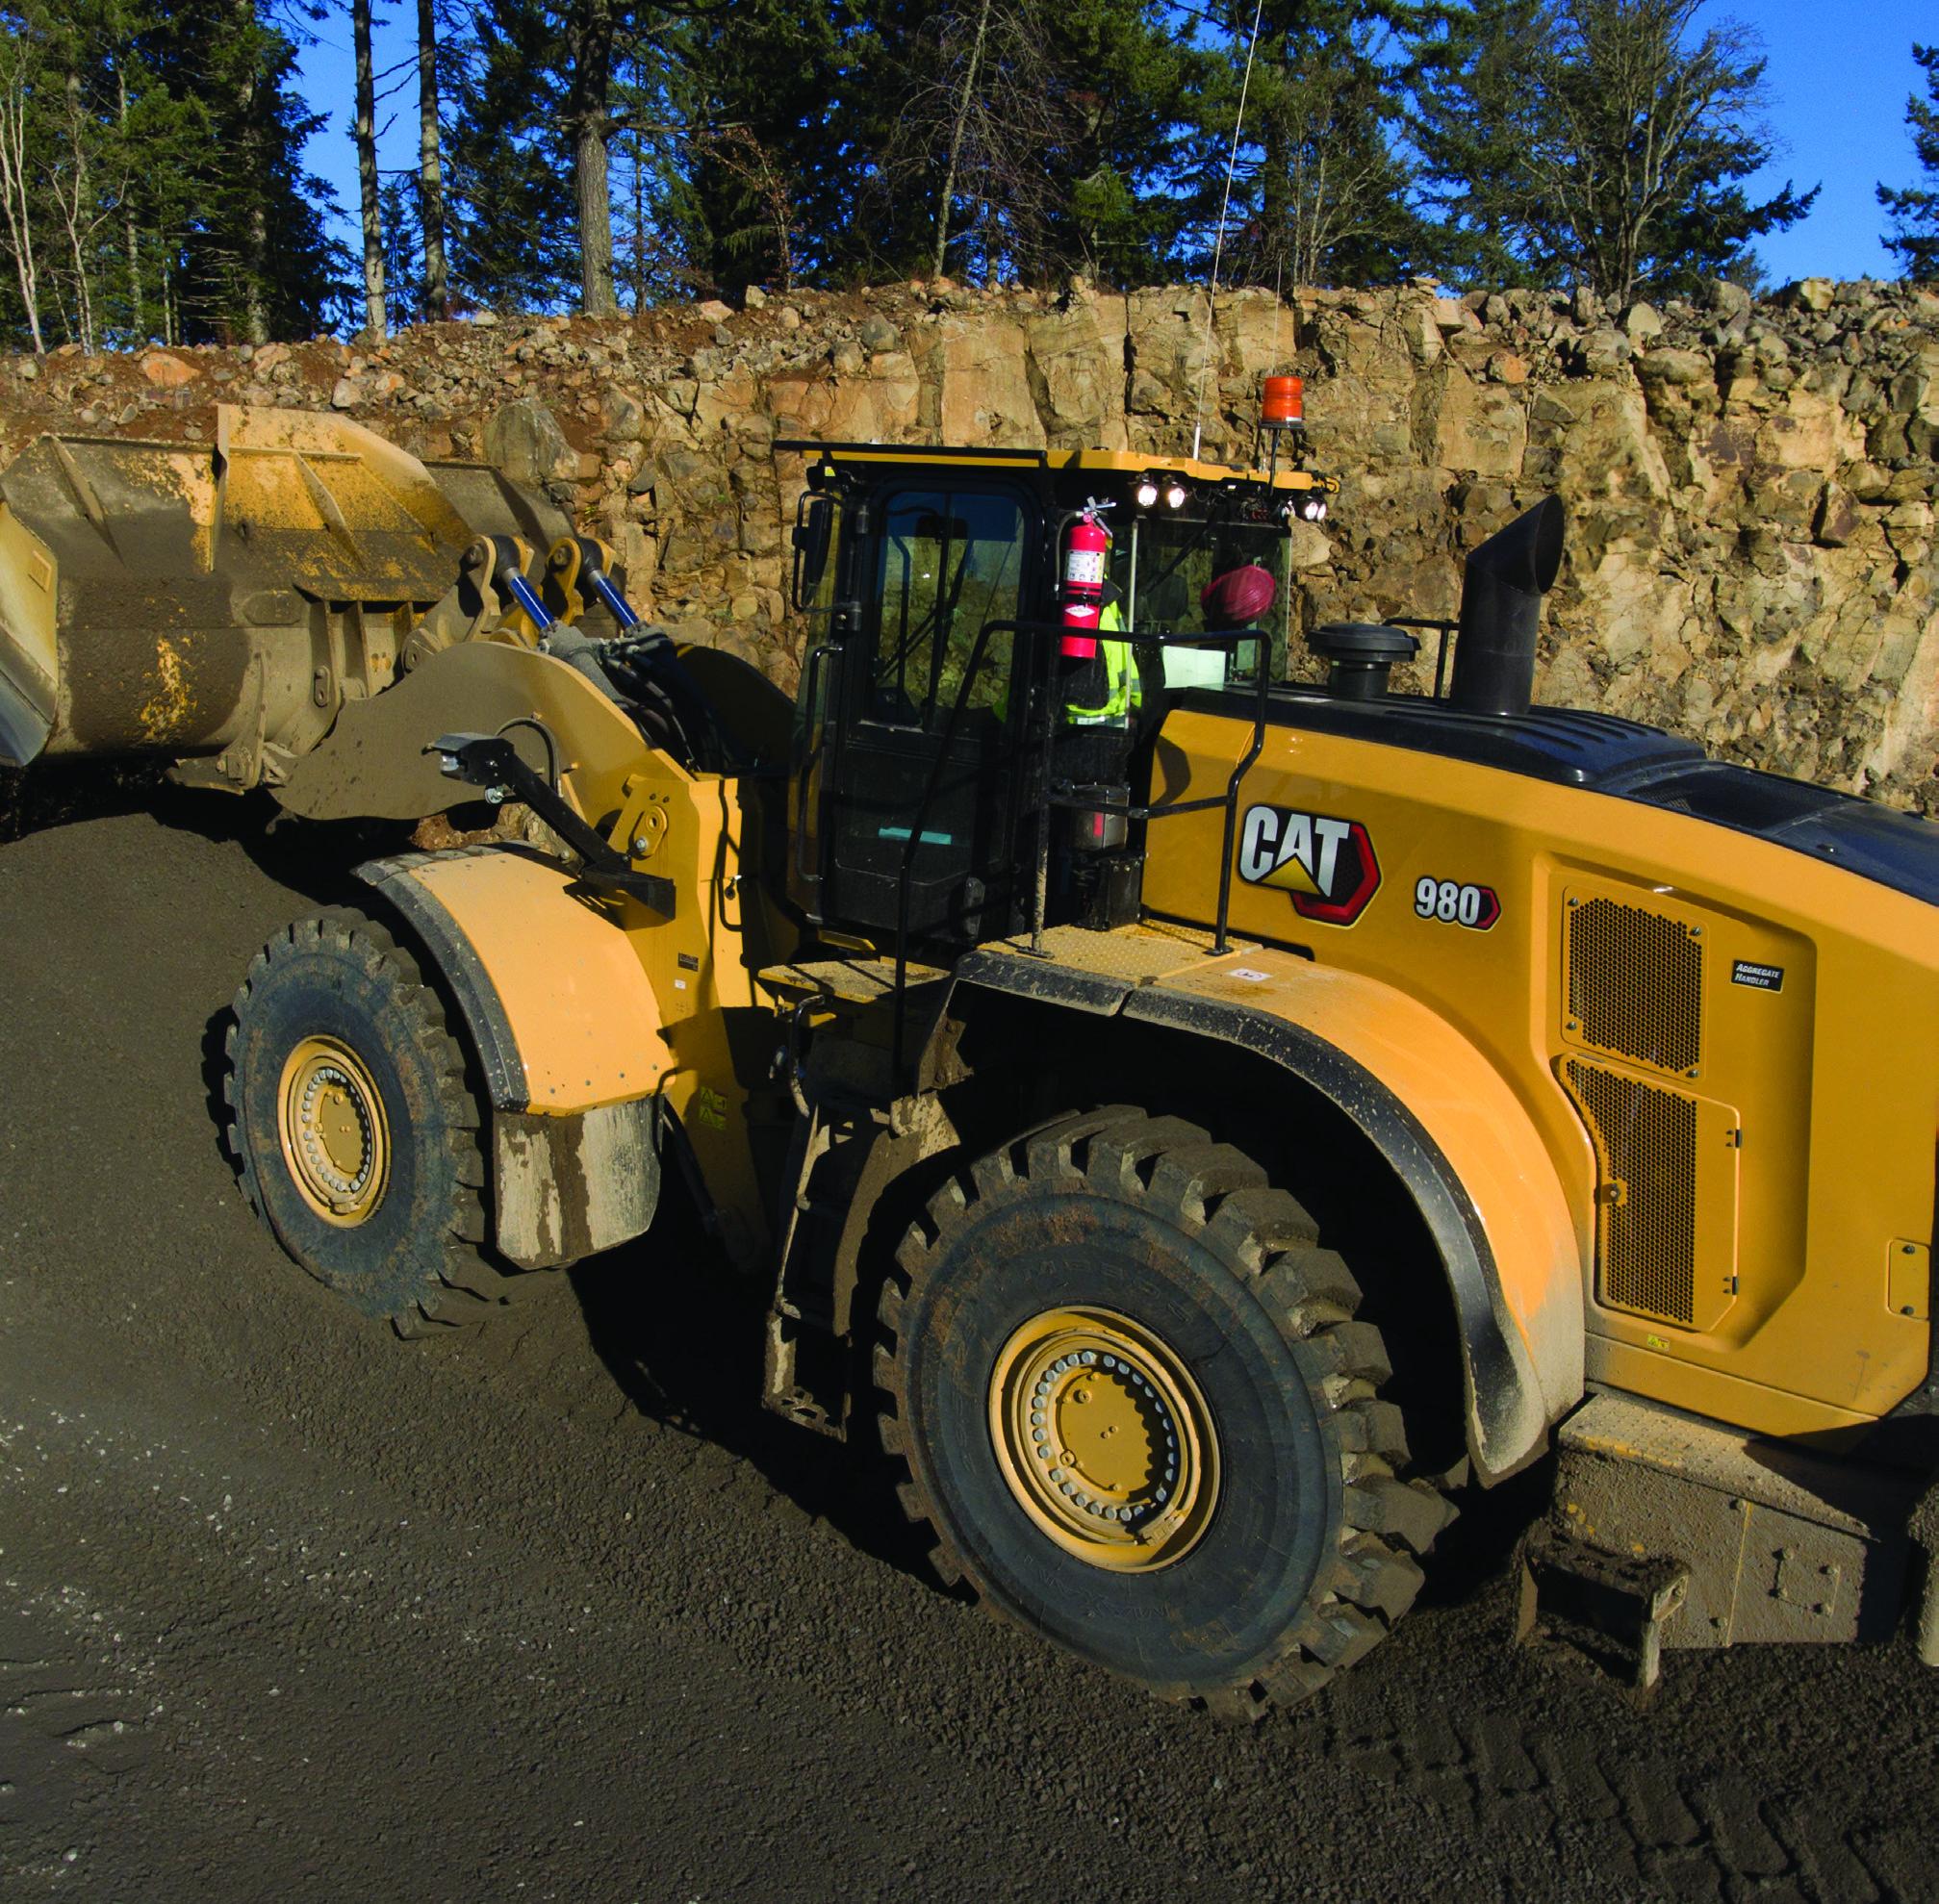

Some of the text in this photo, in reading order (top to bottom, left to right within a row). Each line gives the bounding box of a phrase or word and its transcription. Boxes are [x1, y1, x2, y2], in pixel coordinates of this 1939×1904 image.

[1239, 805, 1350, 898] CAT
[1416, 877, 1481, 925] 980
[1734, 973, 1770, 986] HANDLER
[1736, 963, 1780, 978] AGGREGATE
